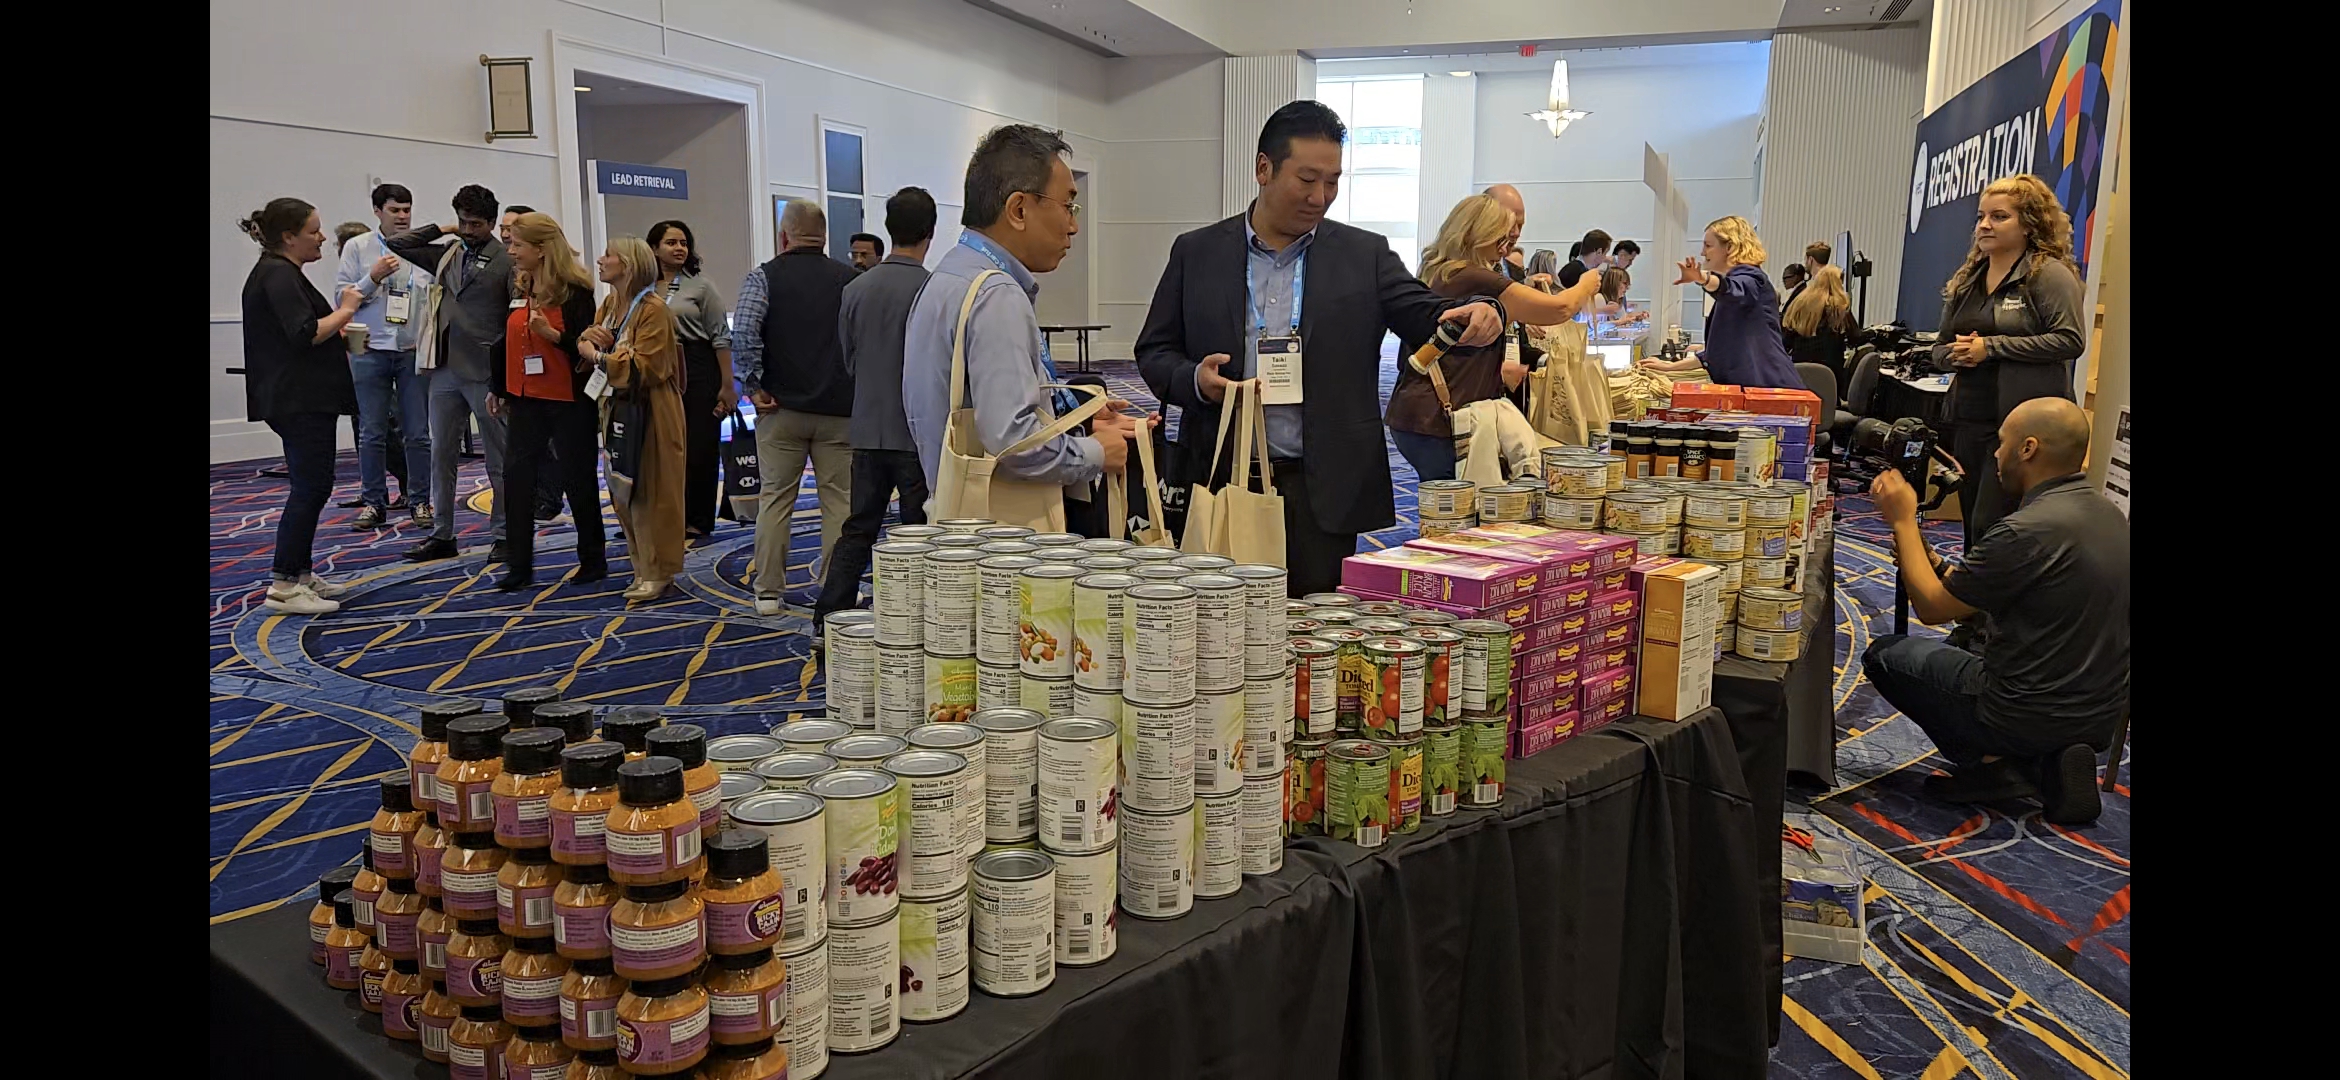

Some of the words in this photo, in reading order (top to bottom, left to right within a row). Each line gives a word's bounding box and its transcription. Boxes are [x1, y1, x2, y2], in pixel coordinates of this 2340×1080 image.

[1926, 106, 2041, 209] REGISTRATION
[611, 172, 633, 186] LEAD
[633, 174, 675, 190] RETRIEVAL
[735, 454, 757, 467] we
[1157, 477, 1186, 506] erc
[1341, 670, 1362, 683] Dic
[943, 691, 975, 704] Vegetab
[1402, 772, 1422, 788] Dic
[942, 798, 954, 806] 110
